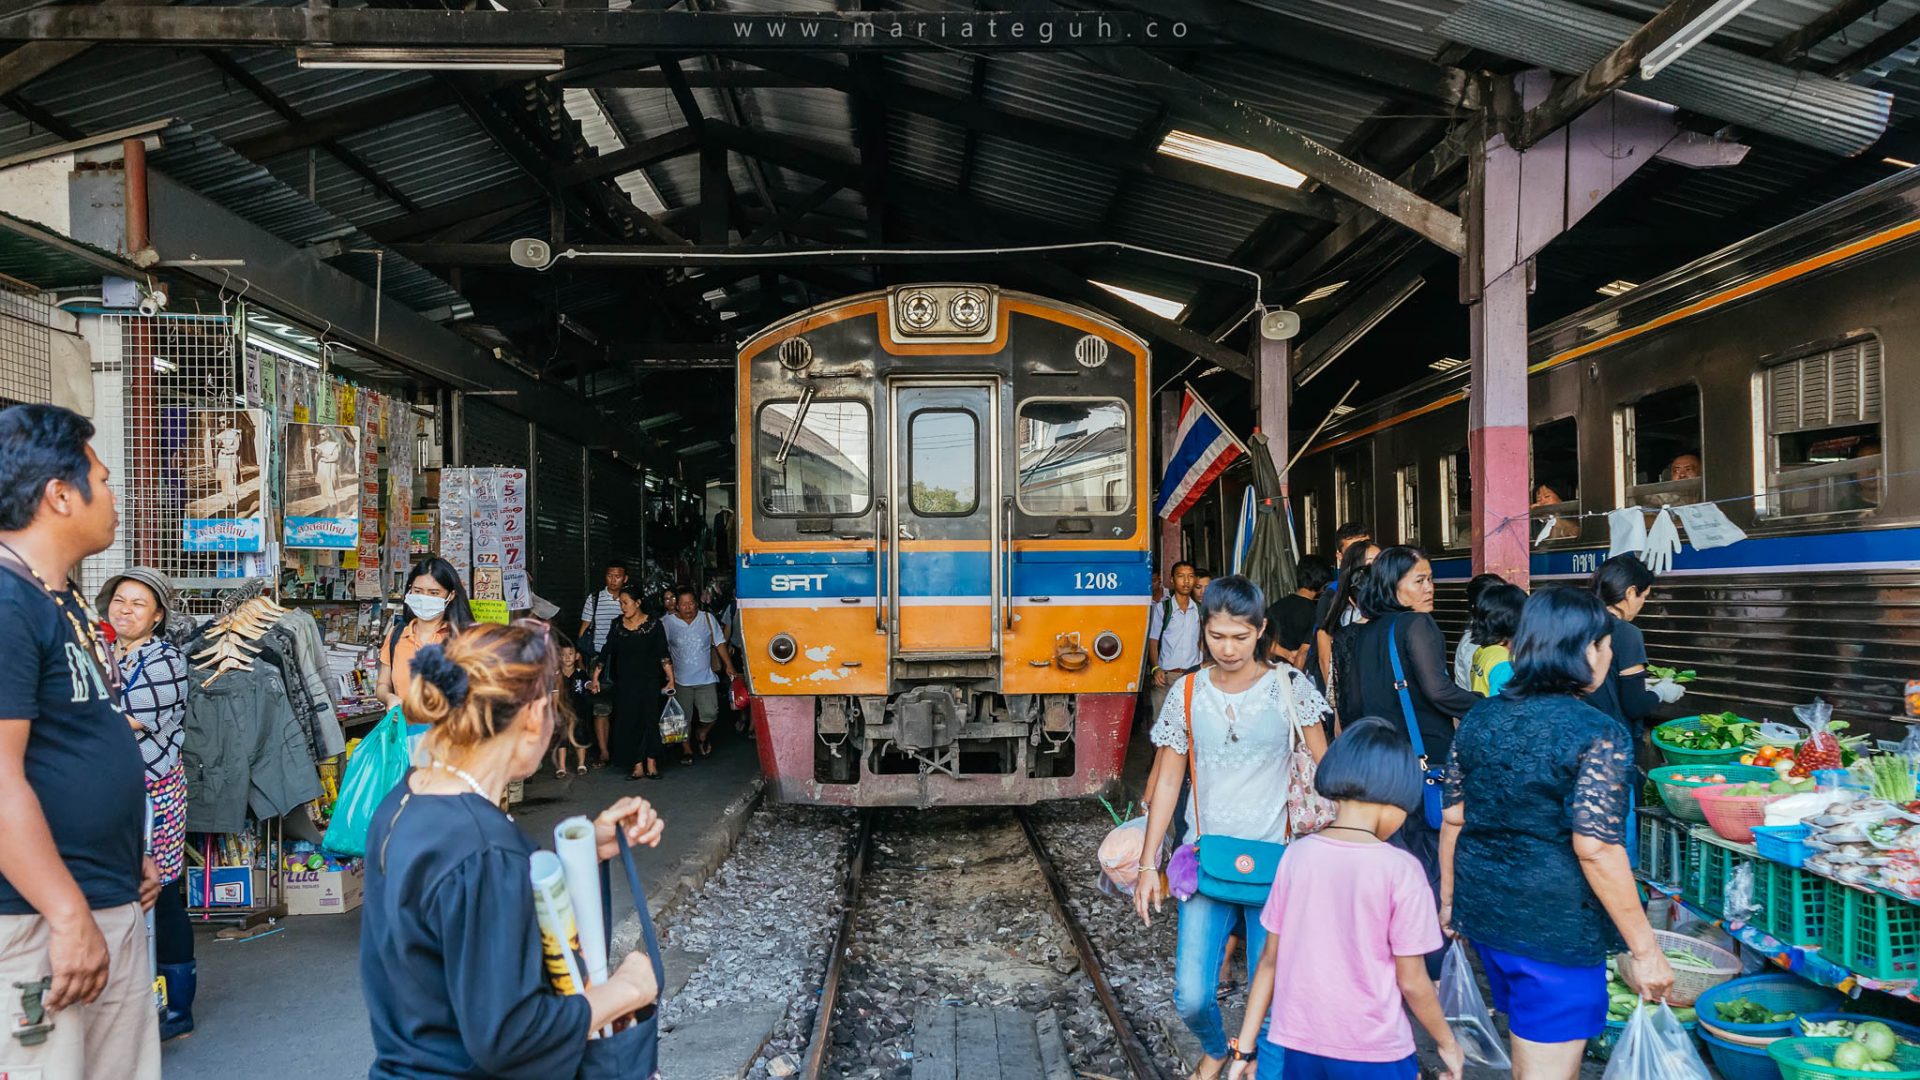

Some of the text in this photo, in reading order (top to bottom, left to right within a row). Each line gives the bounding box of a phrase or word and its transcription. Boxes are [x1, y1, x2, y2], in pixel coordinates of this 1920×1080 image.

[504, 485, 515, 496] 5
[504, 520, 516, 532] 2
[477, 554, 499, 563] 672
[506, 548, 519, 565] 7
[770, 574, 828, 591] SRT
[1074, 572, 1118, 590] 1208
[510, 586, 520, 599] 7
